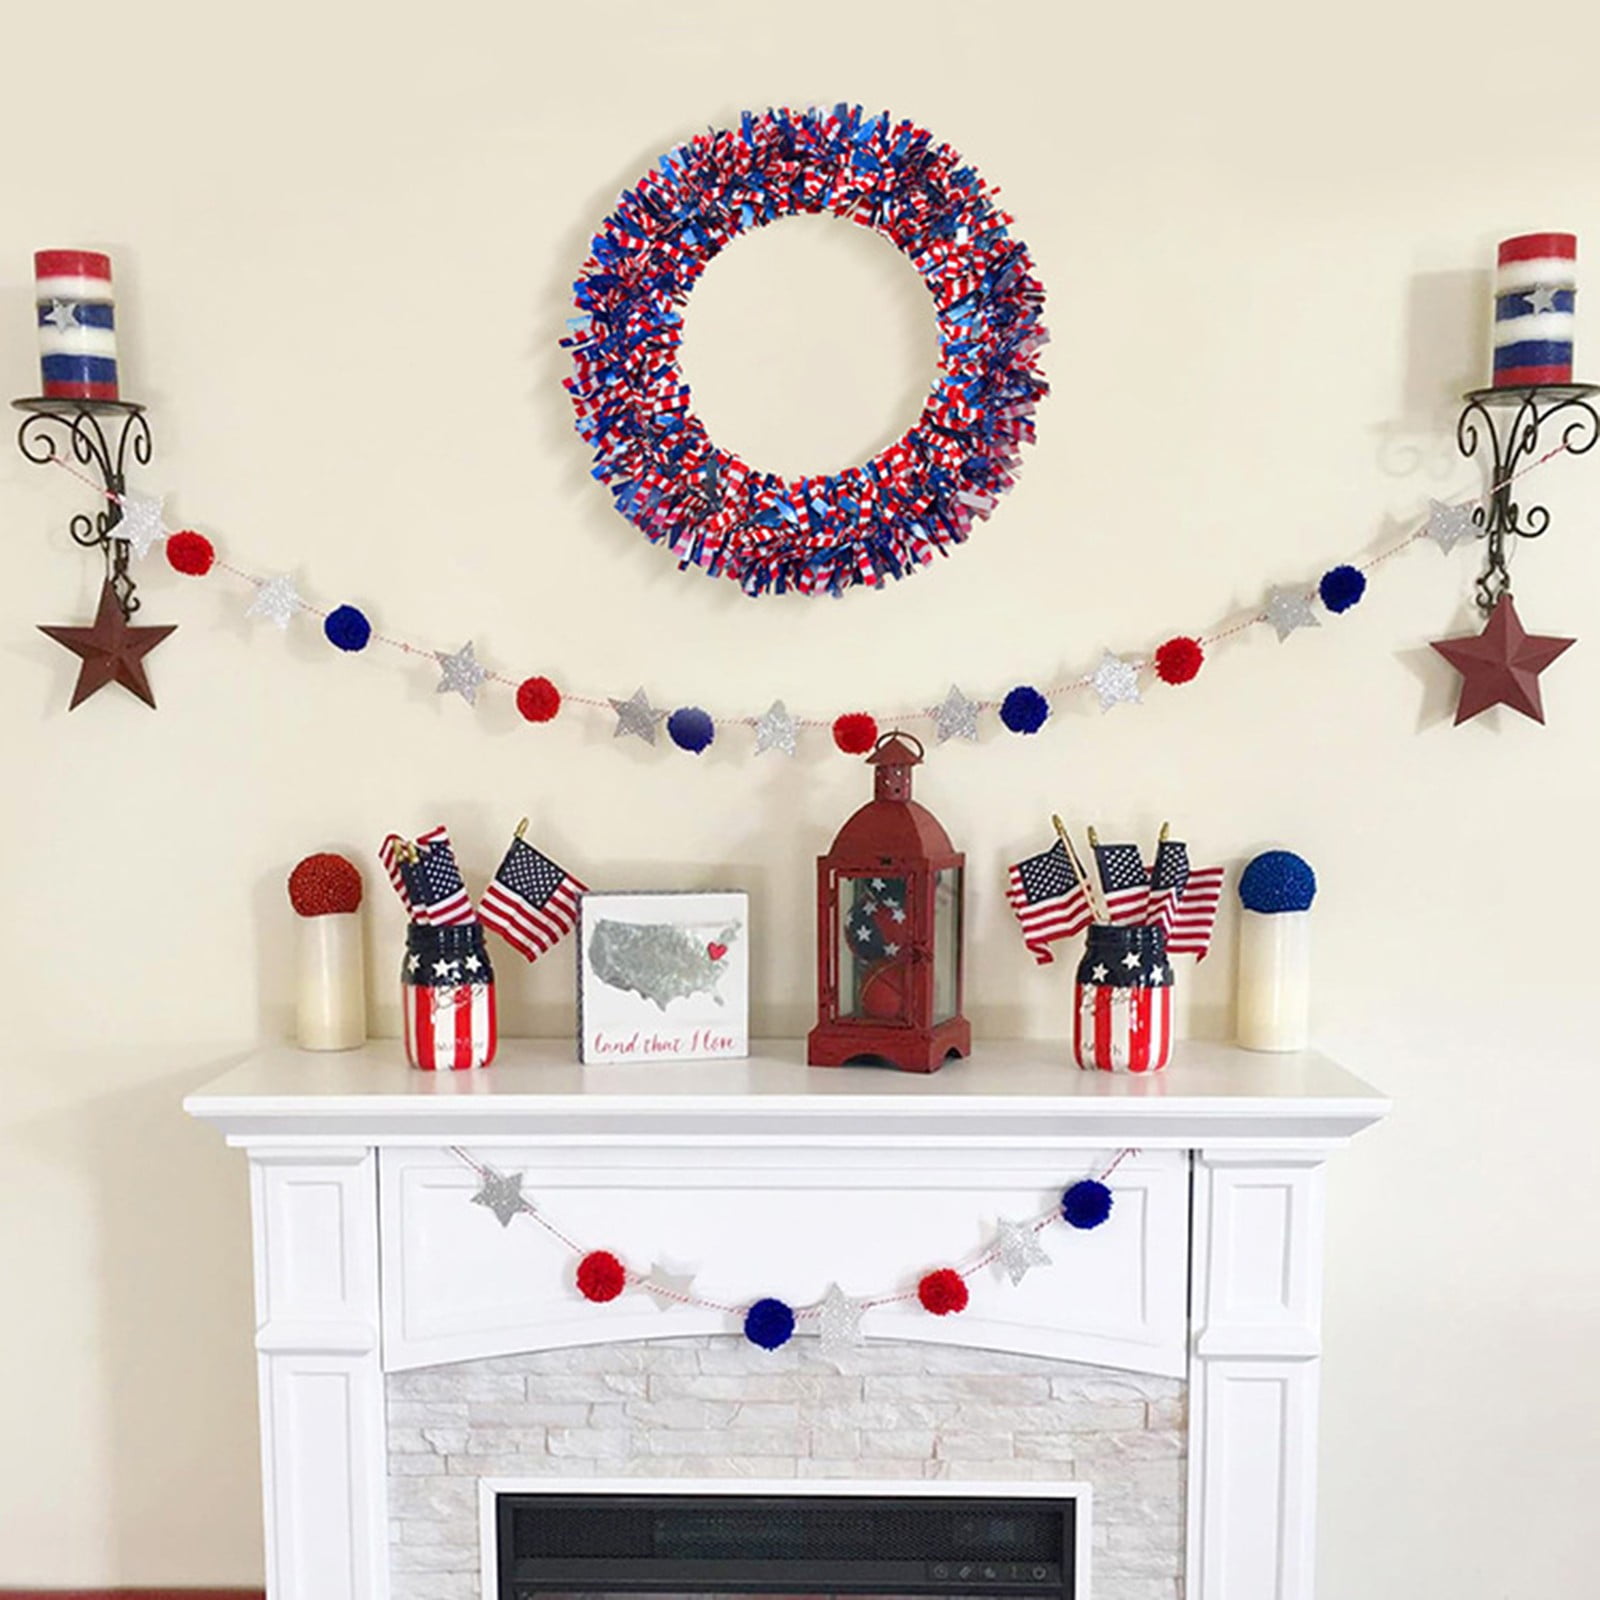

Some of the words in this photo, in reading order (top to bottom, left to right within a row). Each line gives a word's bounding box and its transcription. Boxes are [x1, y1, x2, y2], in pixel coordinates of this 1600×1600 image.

[594, 1032, 639, 1055] land
[644, 1033, 681, 1053] that
[691, 1030, 700, 1051] I
[703, 1029, 736, 1051] love
